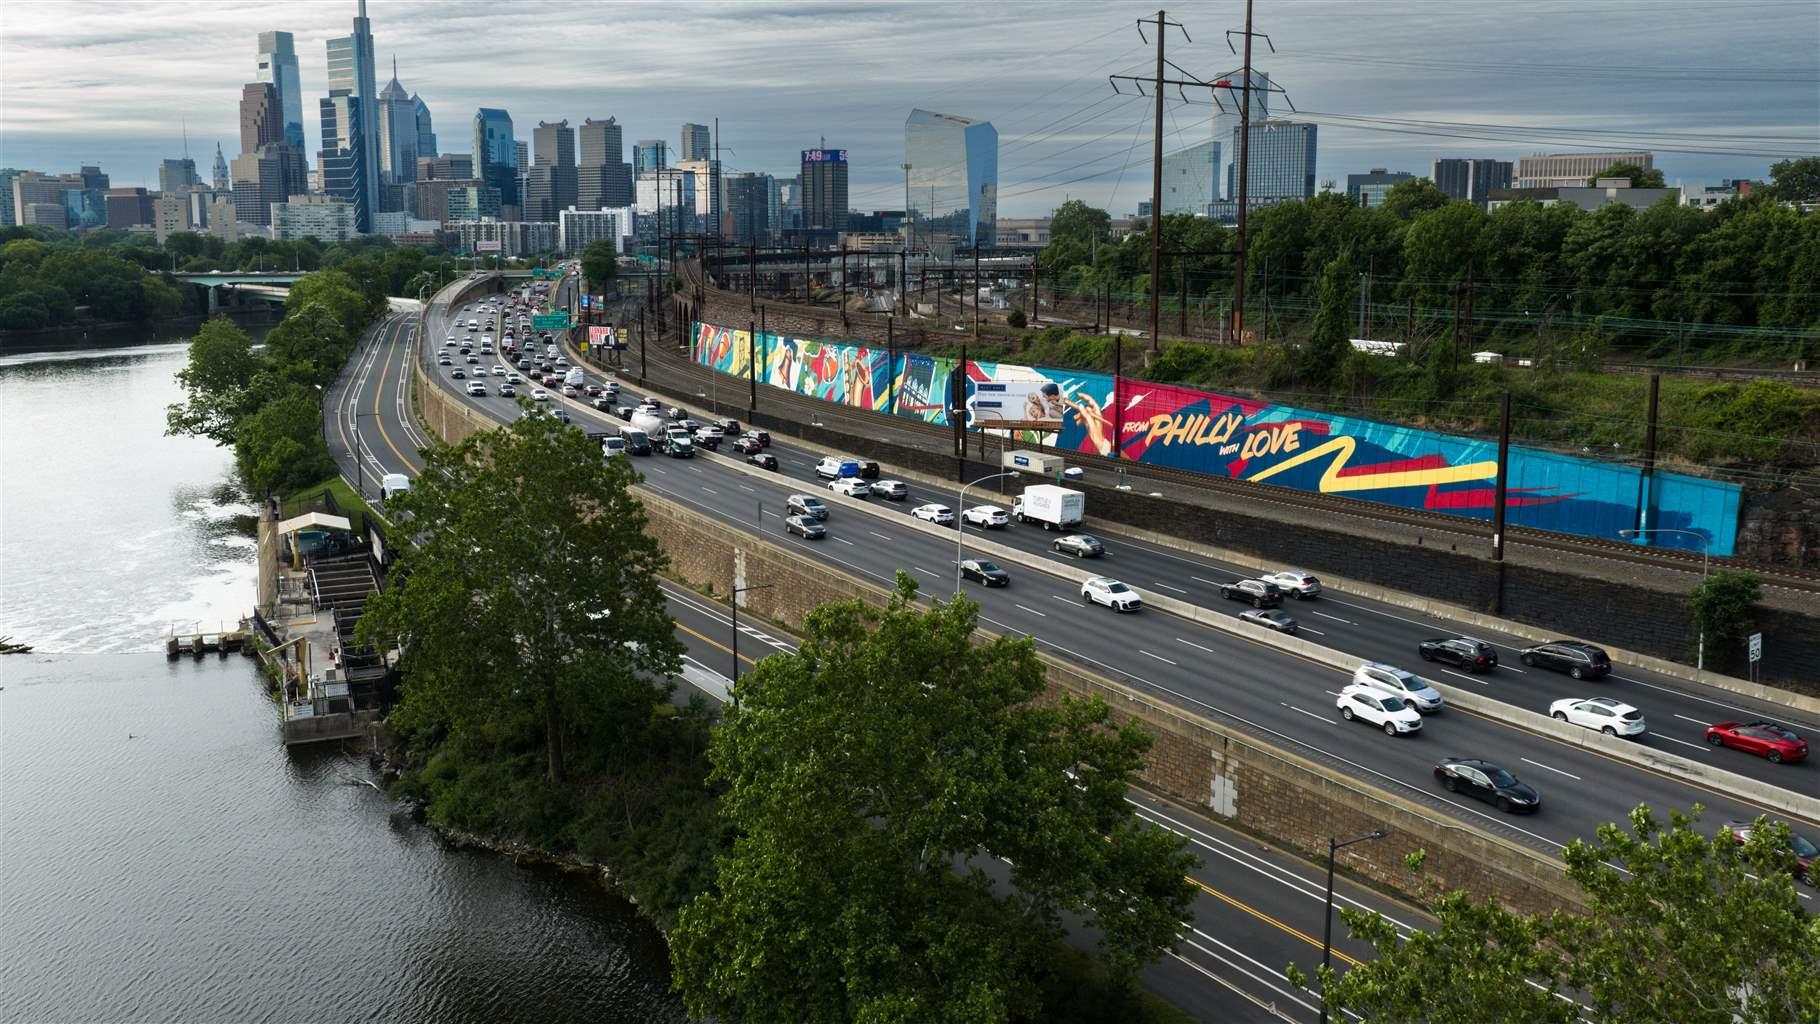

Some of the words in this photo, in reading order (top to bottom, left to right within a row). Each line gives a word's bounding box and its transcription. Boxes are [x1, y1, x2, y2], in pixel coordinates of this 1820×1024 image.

[804, 151, 822, 161] 7:49
[1122, 421, 1149, 433] FROM
[1145, 413, 1243, 447] PHILLY
[1219, 443, 1240, 456] WITH
[1240, 422, 1302, 461] LOVE
[1750, 648, 1760, 660] 50
